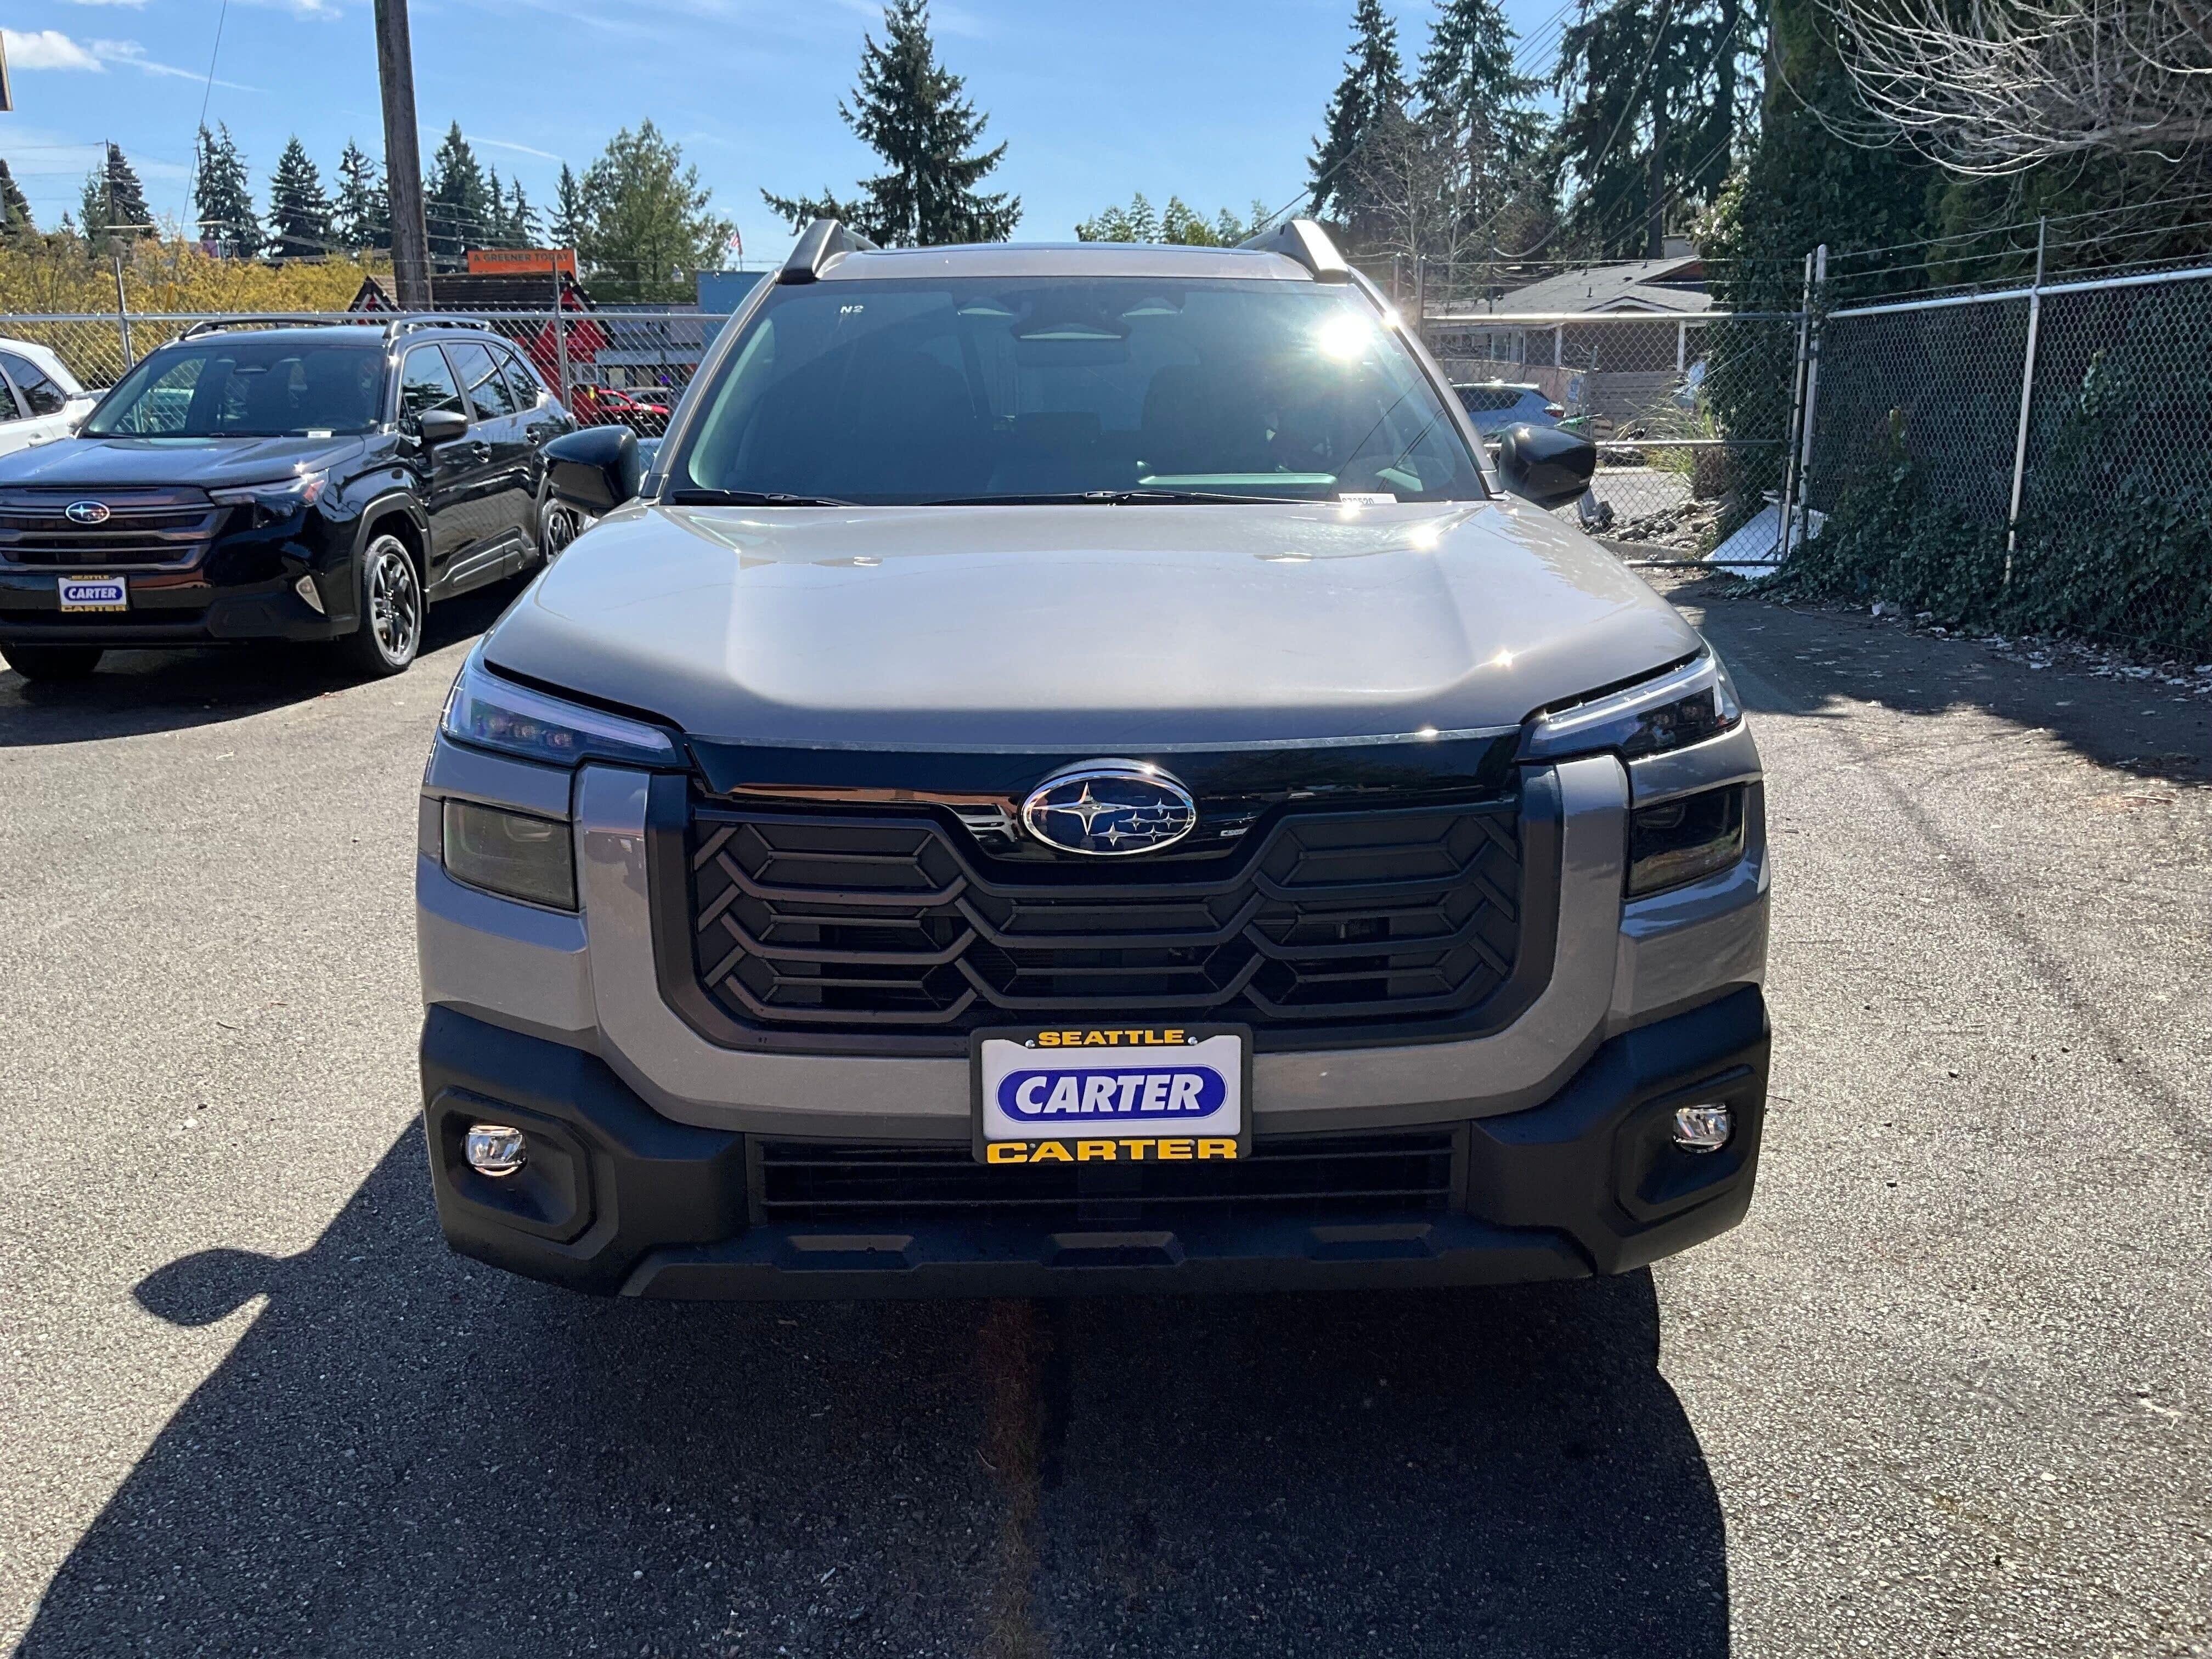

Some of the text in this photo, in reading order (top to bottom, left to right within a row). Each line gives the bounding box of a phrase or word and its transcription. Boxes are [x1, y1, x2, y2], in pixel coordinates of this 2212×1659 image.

[484, 253, 531, 262] GREENER
[69, 588, 117, 599] CARTER
[1039, 1030, 1184, 1045] SEATTLE
[1015, 1074, 1204, 1114] CARTER
[987, 1139, 1237, 1163] CARTER
